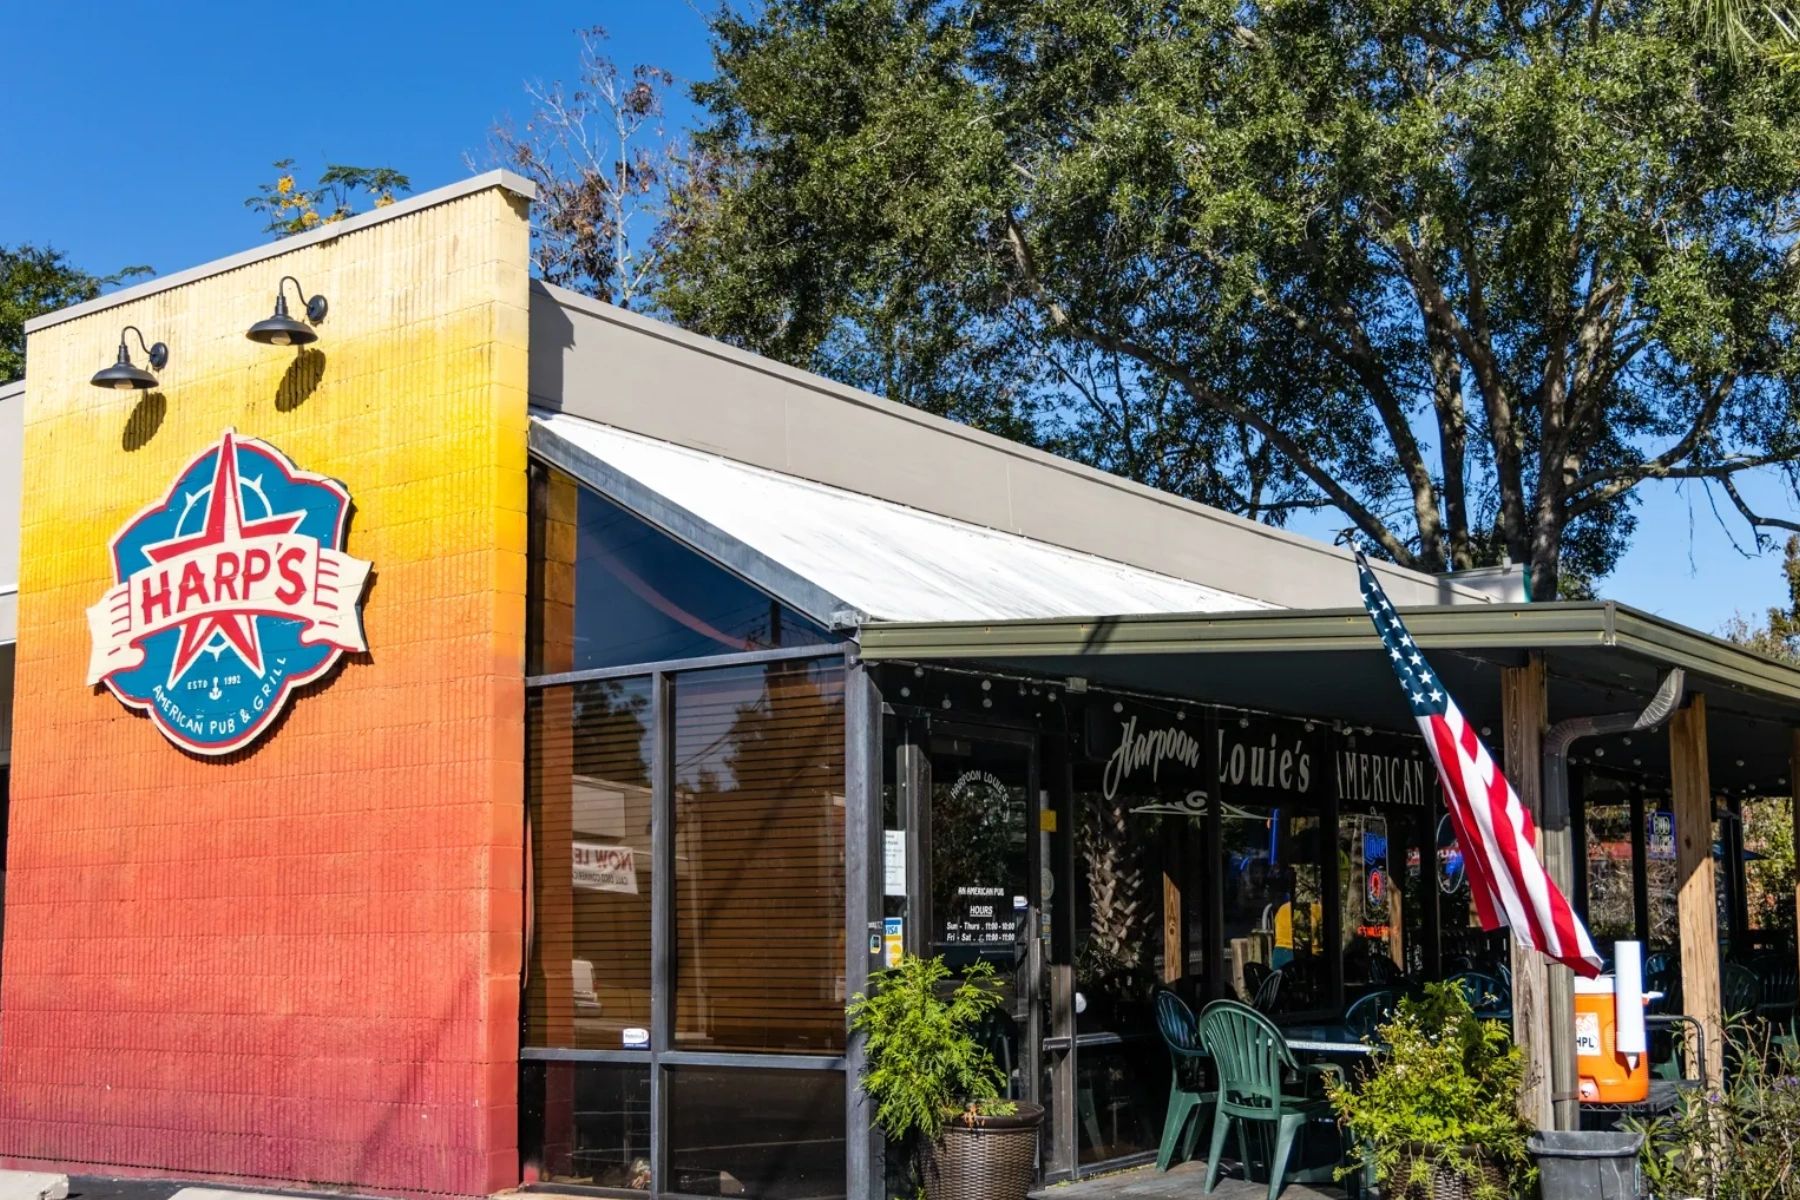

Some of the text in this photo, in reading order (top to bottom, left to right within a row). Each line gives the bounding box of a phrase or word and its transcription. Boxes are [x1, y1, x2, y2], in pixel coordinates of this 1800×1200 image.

[141, 542, 307, 625] HARP'S
[187, 675, 241, 690] ESTD 1992
[152, 657, 287, 735] AMERICAN PUB & GRILL
[1103, 715, 1200, 800] Harpoon
[1218, 729, 1310, 793] Louie's
[950, 769, 1009, 802] HARPOON LOUIE'S
[958, 887, 1004, 896] AN AMERICAN PUB
[970, 905, 993, 915] HOURS
[947, 922, 958, 930] Sun
[964, 922, 980, 930] Thurs
[947, 933, 955, 942] Fri
[961, 933, 972, 942] Sat
